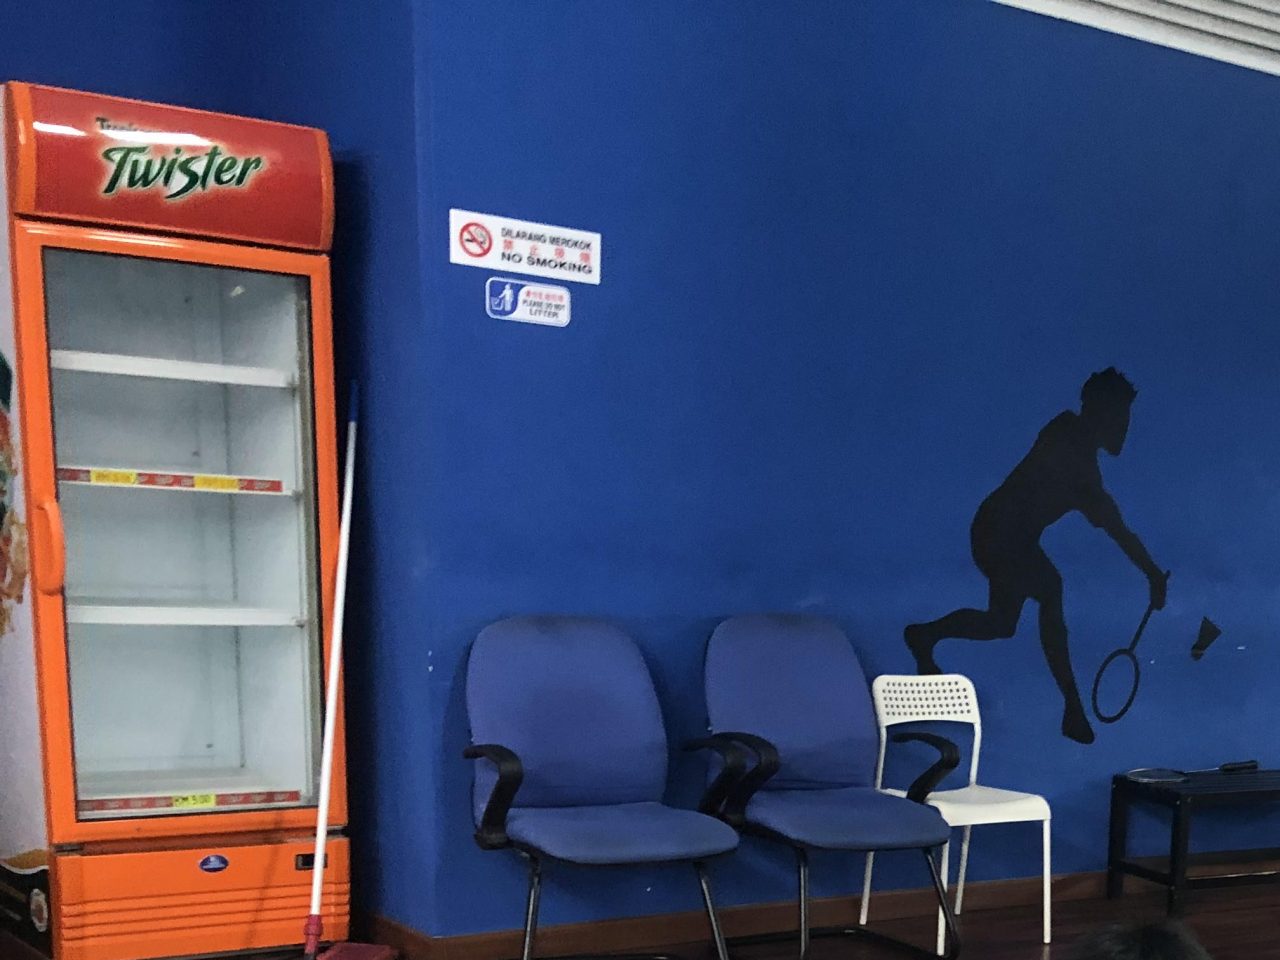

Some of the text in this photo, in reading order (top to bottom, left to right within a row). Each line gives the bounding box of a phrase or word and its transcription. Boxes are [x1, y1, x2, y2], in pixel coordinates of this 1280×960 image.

[102, 145, 262, 199] Twister
[501, 227, 547, 244] DILARANG
[549, 235, 592, 250] MEROKOK
[501, 251, 523, 264] NO
[526, 255, 593, 275] SMOKING
